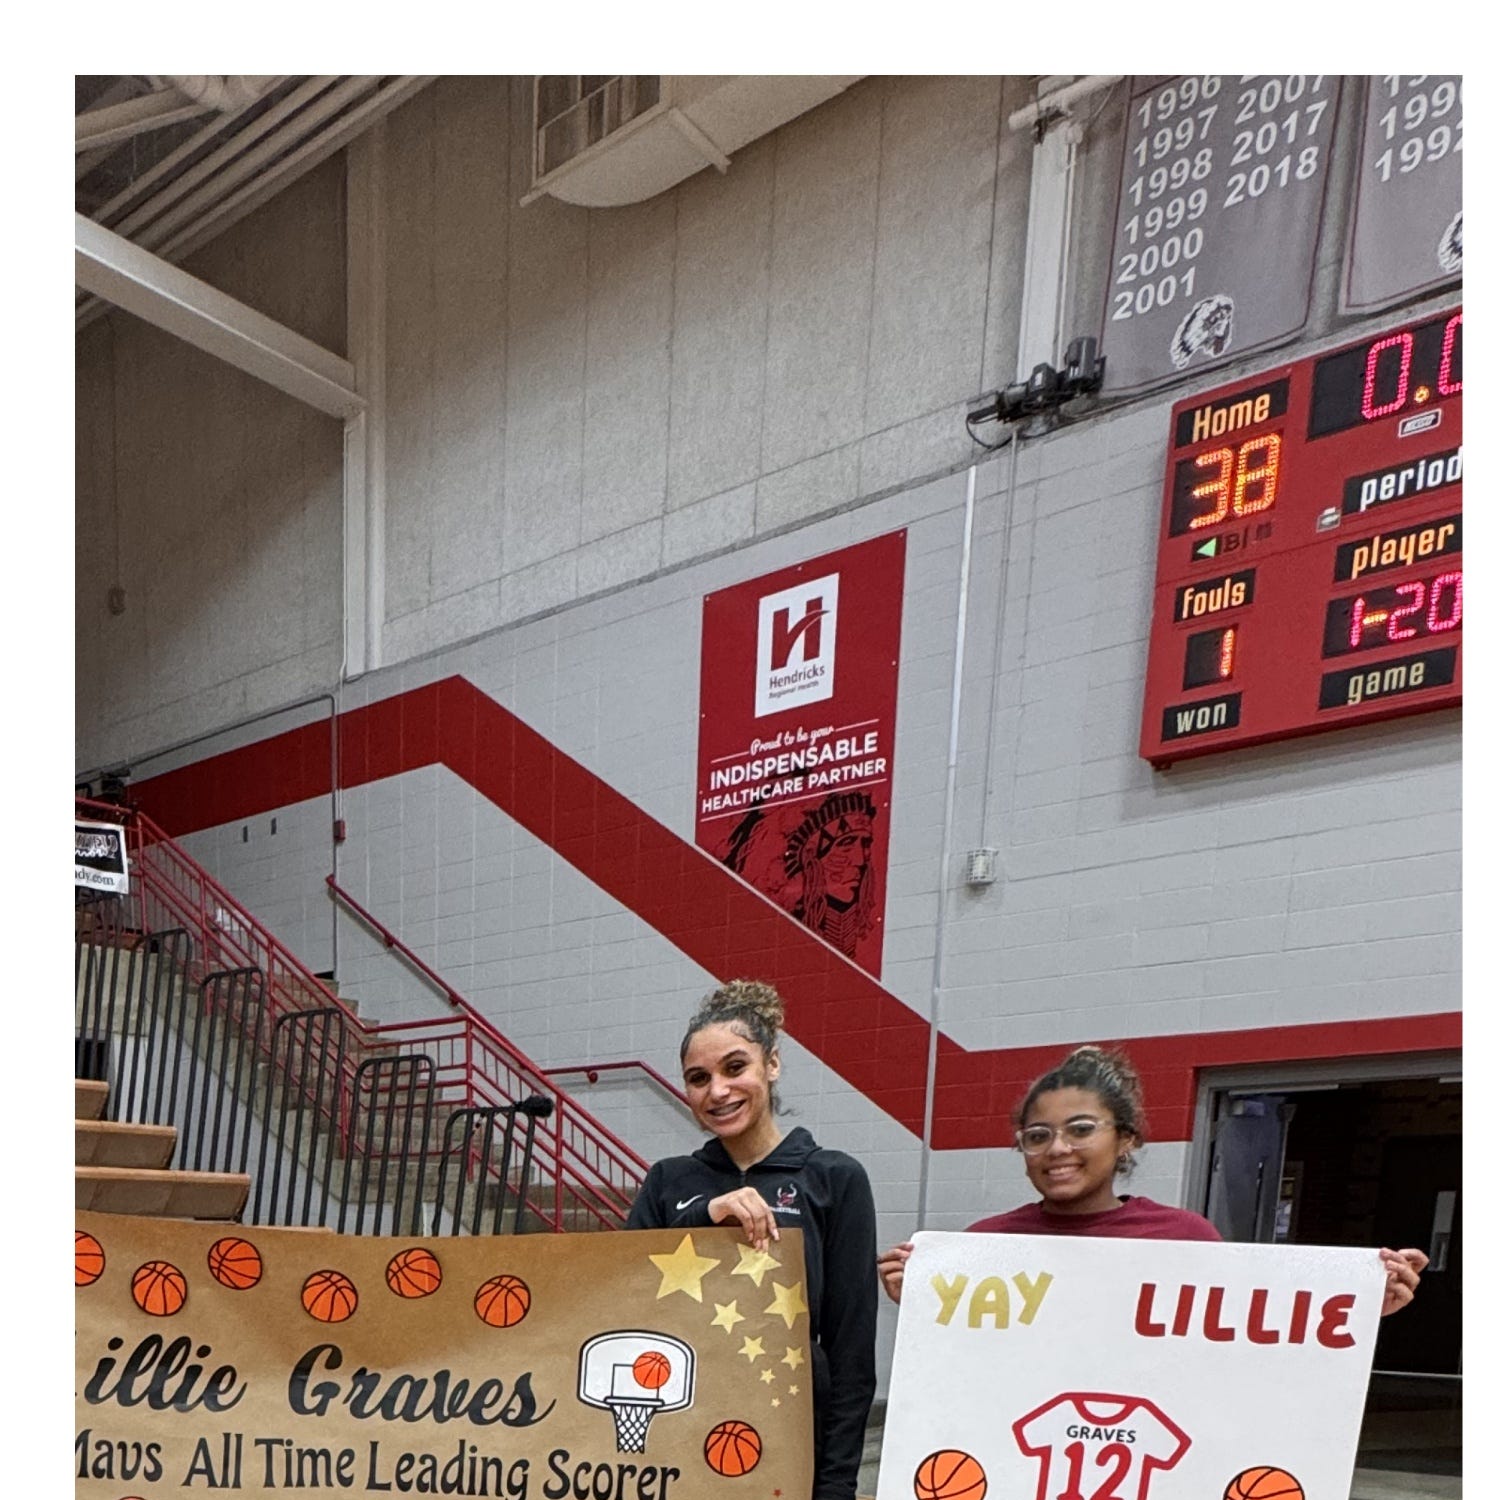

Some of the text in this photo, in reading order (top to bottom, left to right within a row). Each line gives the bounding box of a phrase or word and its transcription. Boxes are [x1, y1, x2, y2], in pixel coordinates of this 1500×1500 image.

[1138, 75, 1222, 129] 1996
[1379, 82, 1463, 140] 199
[1132, 100, 1328, 167] 1997 2017
[1128, 146, 1320, 208] 1998 2018
[1123, 187, 1209, 245] 1999
[1115, 226, 1204, 285] 2000
[1111, 266, 1196, 321] 2001
[1192, 392, 1271, 443] Home
[1189, 432, 1282, 530] 38
[1359, 446, 1463, 512] period
[1350, 522, 1456, 580] player
[1181, 578, 1246, 620] fouls
[769, 663, 825, 689] Hendricks
[1219, 628, 1235, 679] 1
[1347, 659, 1425, 706] game
[750, 725, 834, 757] Proud to be your
[1176, 702, 1228, 735] won
[701, 758, 887, 814] HEALTHCARE PARTNER
[709, 731, 879, 790] INDISPENSABLE
[930, 1270, 1356, 1349] YAY LILLIE
[75, 1333, 557, 1430] illie Graves
[180, 1431, 243, 1490] All
[254, 1436, 354, 1491] Time
[1065, 1423, 1137, 1445] GRAVES
